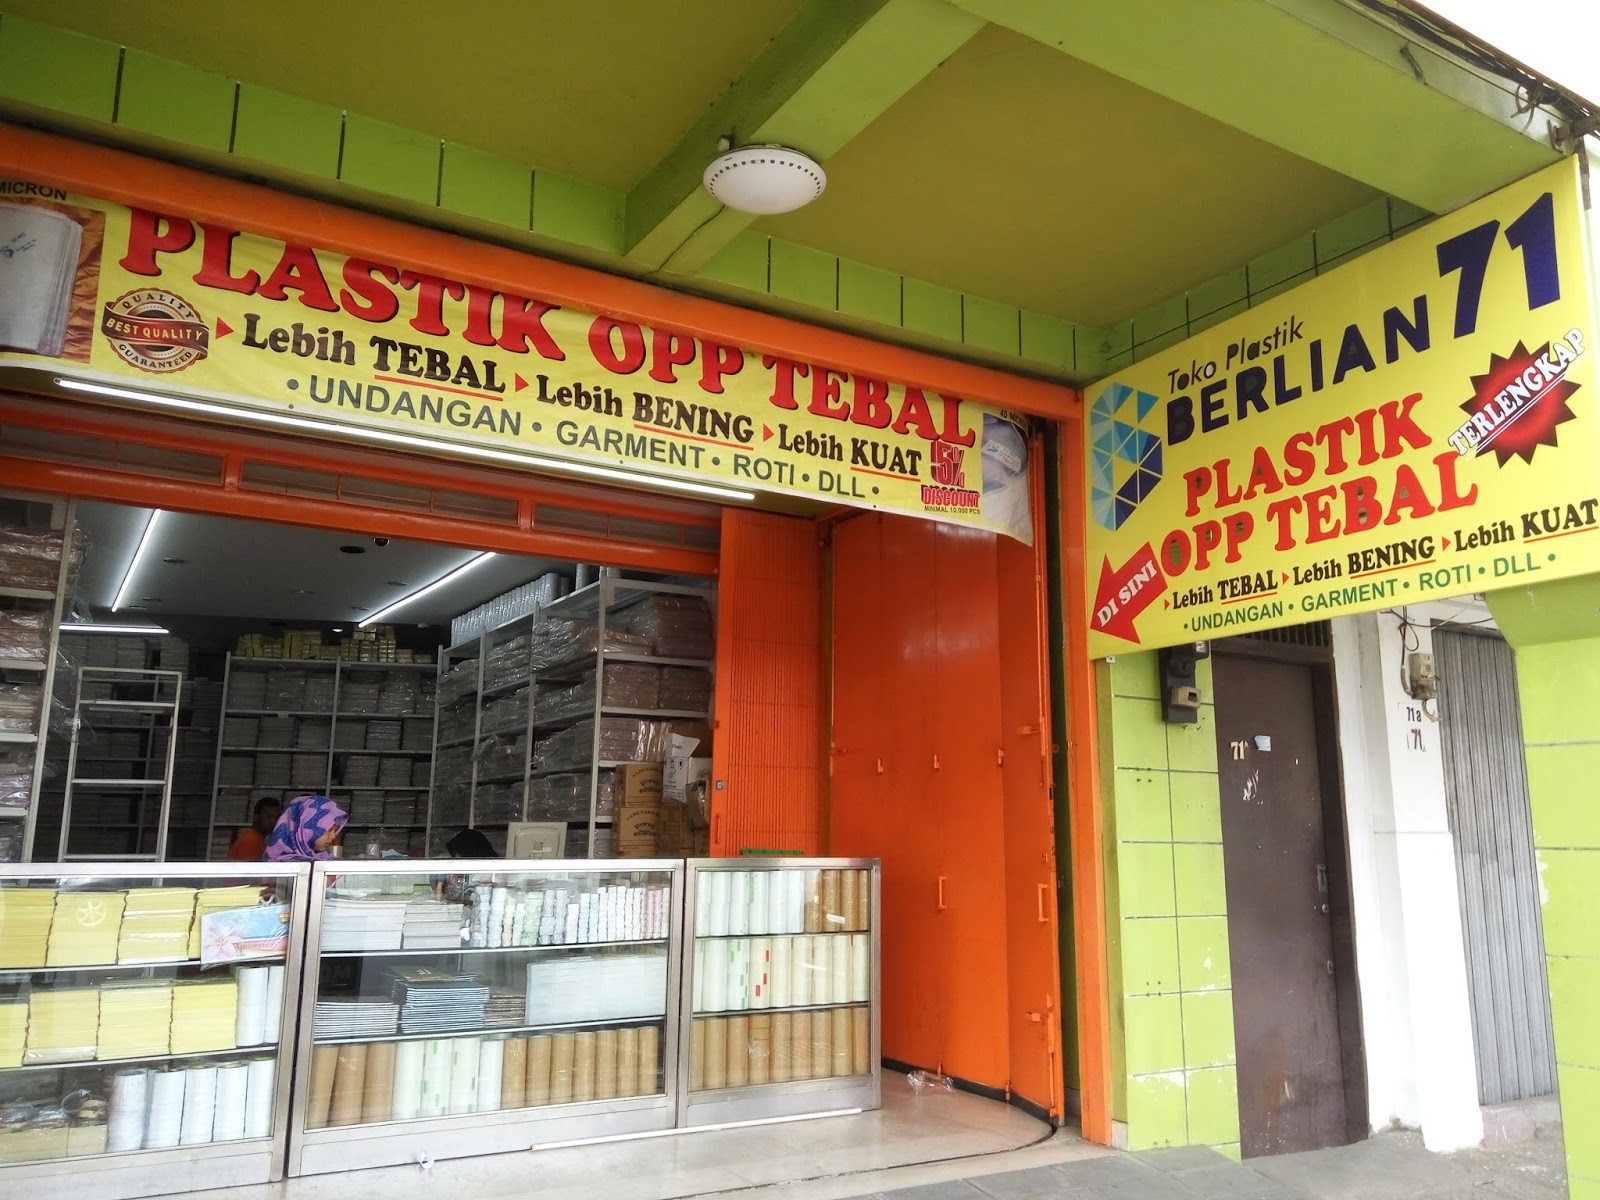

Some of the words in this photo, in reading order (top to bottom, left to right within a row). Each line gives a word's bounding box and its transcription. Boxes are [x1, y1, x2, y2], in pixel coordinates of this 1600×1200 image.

[106, 318, 139, 335] BEST
[143, 327, 203, 341] QUALITY
[119, 206, 566, 361] PLASTIK
[588, 315, 744, 394] OPP
[762, 354, 976, 448] TEBAL
[122, 293, 195, 319] QUALITY
[1167, 294, 1431, 447] BERLIAN
[1436, 192, 1560, 339] 71
[119, 344, 192, 369] GUARANTEED
[242, 313, 356, 365] Lebih
[369, 335, 506, 393] TEBAL
[537, 374, 623, 417] Lebih
[632, 392, 755, 443] BENING
[778, 423, 844, 462] Lebih
[850, 437, 922, 476] KUAT
[1168, 360, 1217, 394] Toko
[1226, 315, 1304, 370] Plastik
[1447, 328, 1585, 457] TERLENGKAP
[309, 375, 521, 436] UNDANGAN
[557, 420, 706, 469] GARMENT
[734, 453, 795, 486] ROTI
[819, 470, 866, 499] DLL
[930, 440, 965, 488] 5%
[1183, 392, 1432, 517] PLASTIK
[921, 485, 980, 508] DISCOUNT
[924, 505, 949, 513] MINIMAL
[1161, 511, 1255, 577] OPP
[1266, 451, 1479, 551] TEBAL
[1097, 600, 1120, 627] DI
[1118, 559, 1159, 606] SINI
[1172, 586, 1214, 610] Lebih
[1217, 570, 1278, 600] TEBAL
[1293, 555, 1342, 586] Lebih
[1347, 536, 1435, 575] BENING
[1454, 520, 1515, 552] Lebih
[1521, 498, 1599, 538] KUAT
[1191, 601, 1283, 632] UNDANGAN
[1301, 578, 1398, 613] GARMENT
[1419, 564, 1471, 591] ROTI
[1493, 552, 1541, 577] DLL
